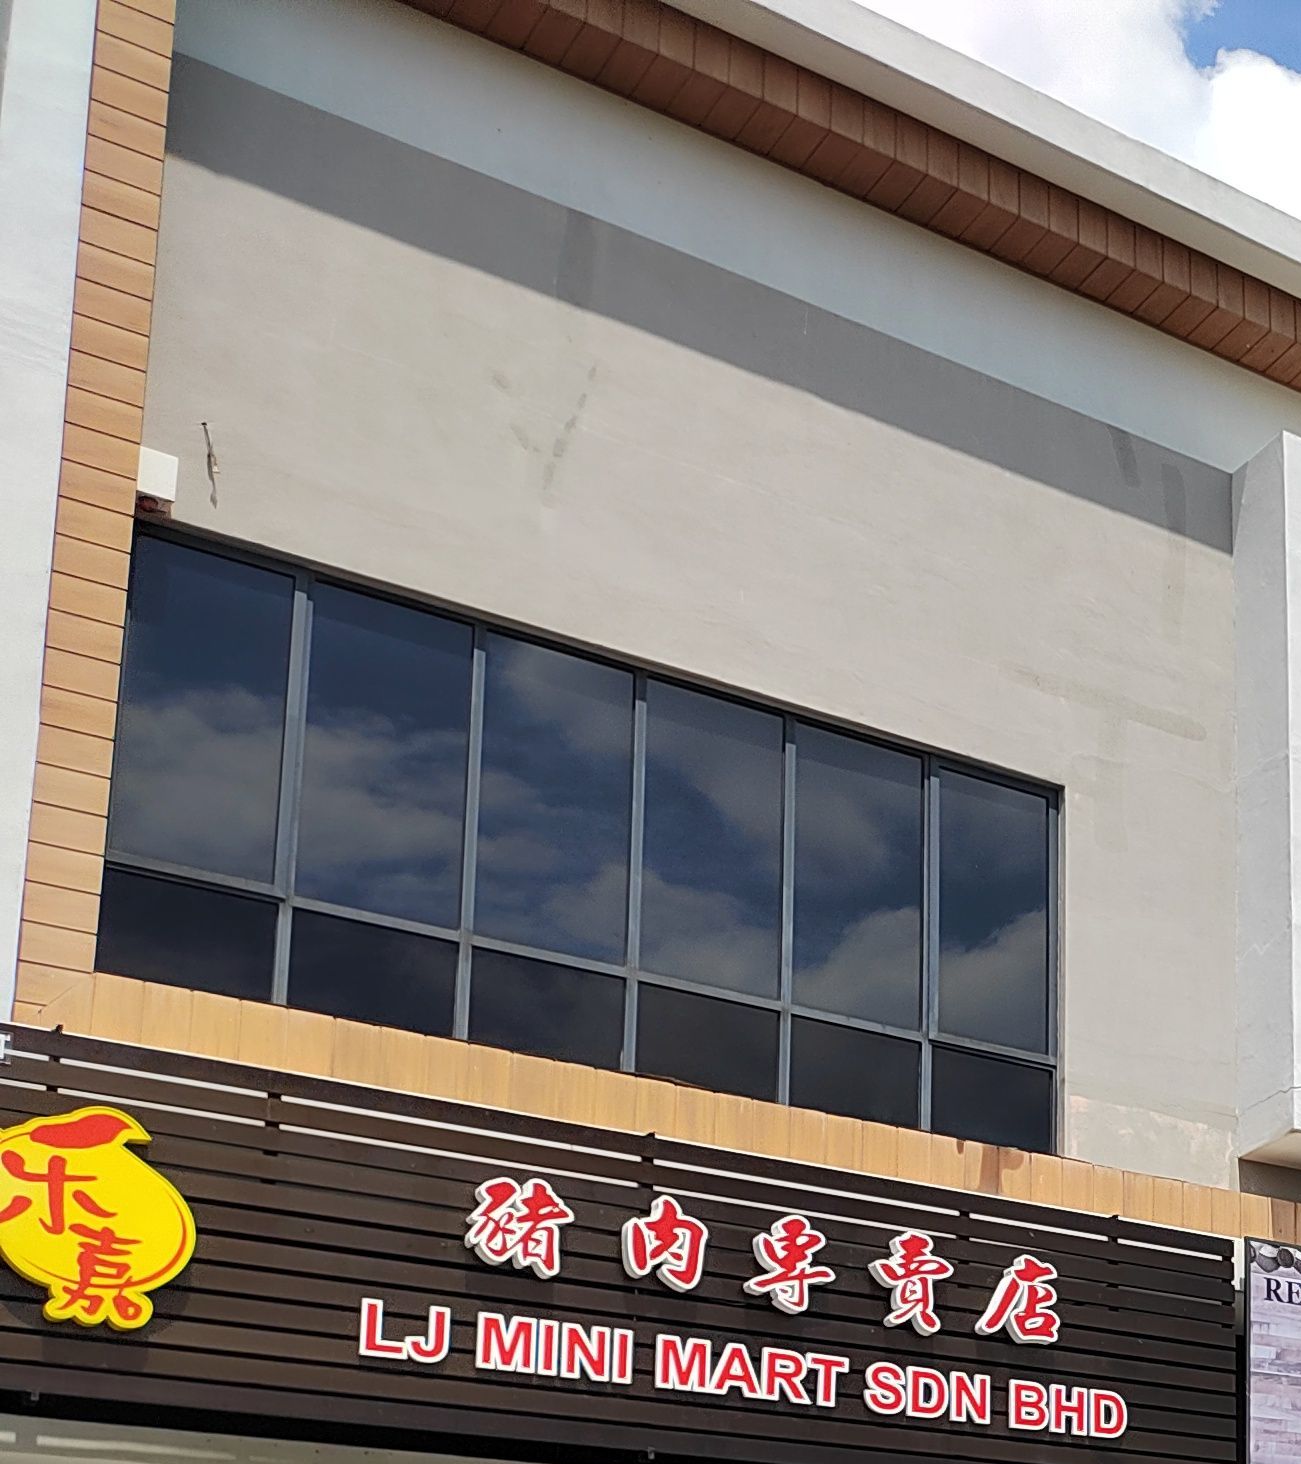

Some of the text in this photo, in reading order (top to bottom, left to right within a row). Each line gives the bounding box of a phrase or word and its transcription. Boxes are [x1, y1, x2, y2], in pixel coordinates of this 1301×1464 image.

[358, 1297, 1128, 1439] LJ MINI MART SDN BHD
